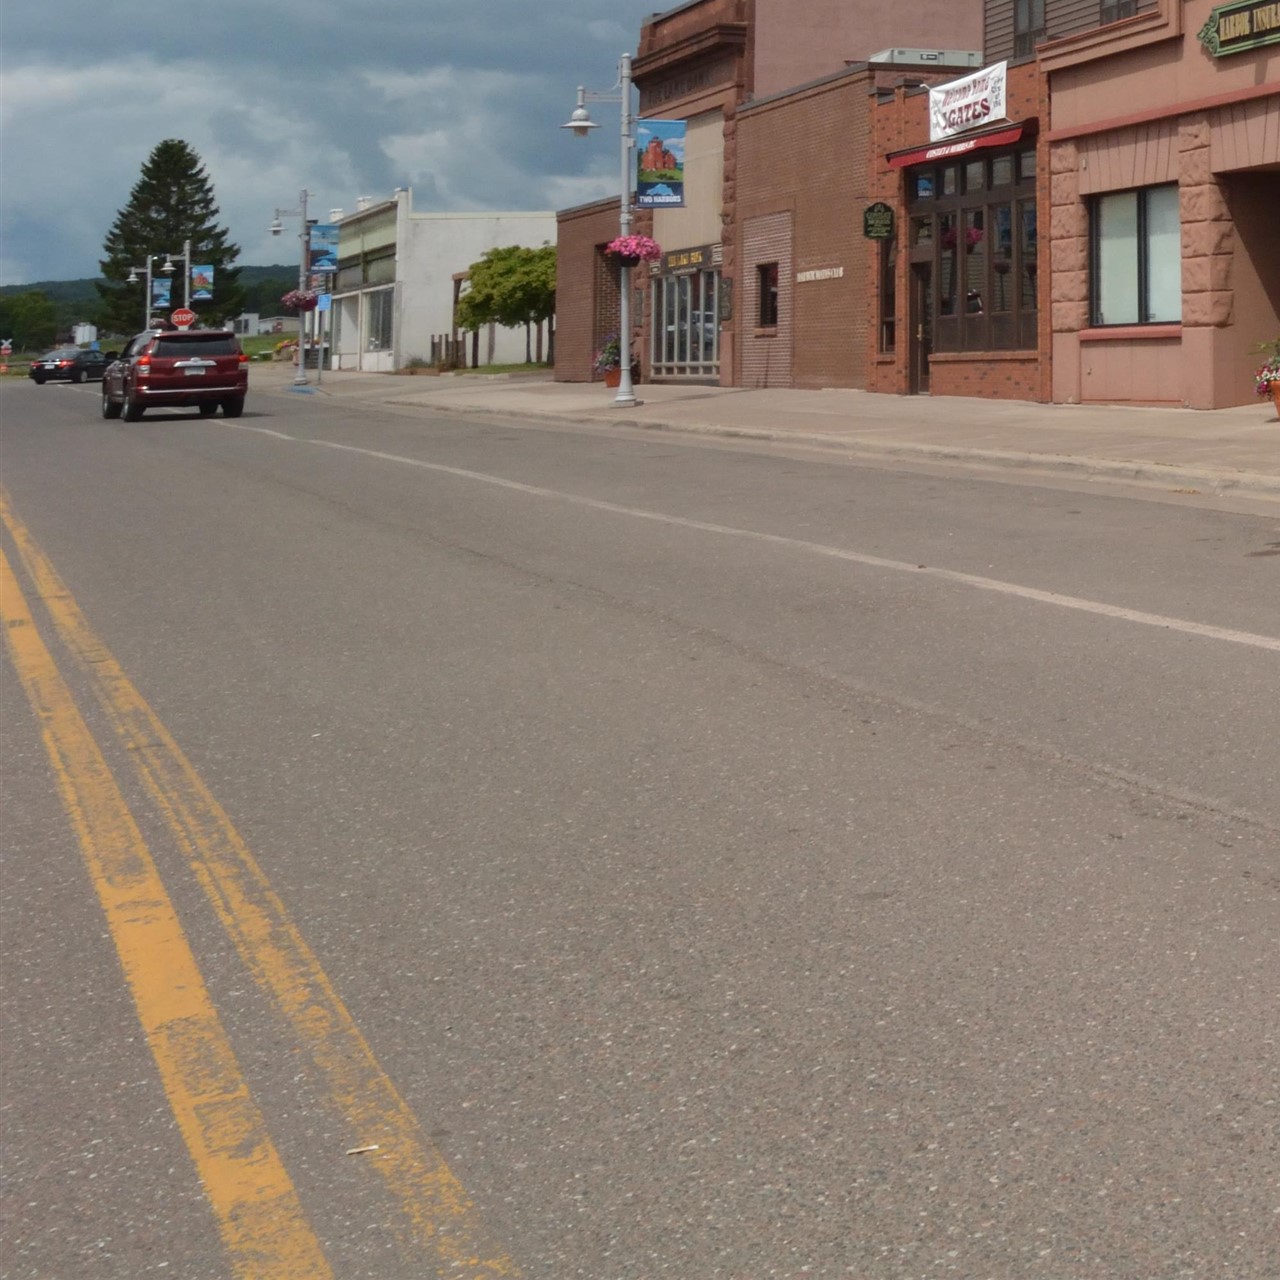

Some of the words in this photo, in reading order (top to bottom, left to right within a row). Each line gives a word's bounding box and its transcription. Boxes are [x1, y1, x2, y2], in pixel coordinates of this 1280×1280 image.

[1219, 10, 1250, 42] HARBOR
[639, 195, 652, 203] TWO
[654, 195, 681, 203] HARBORS
[173, 313, 193, 323] STOP
